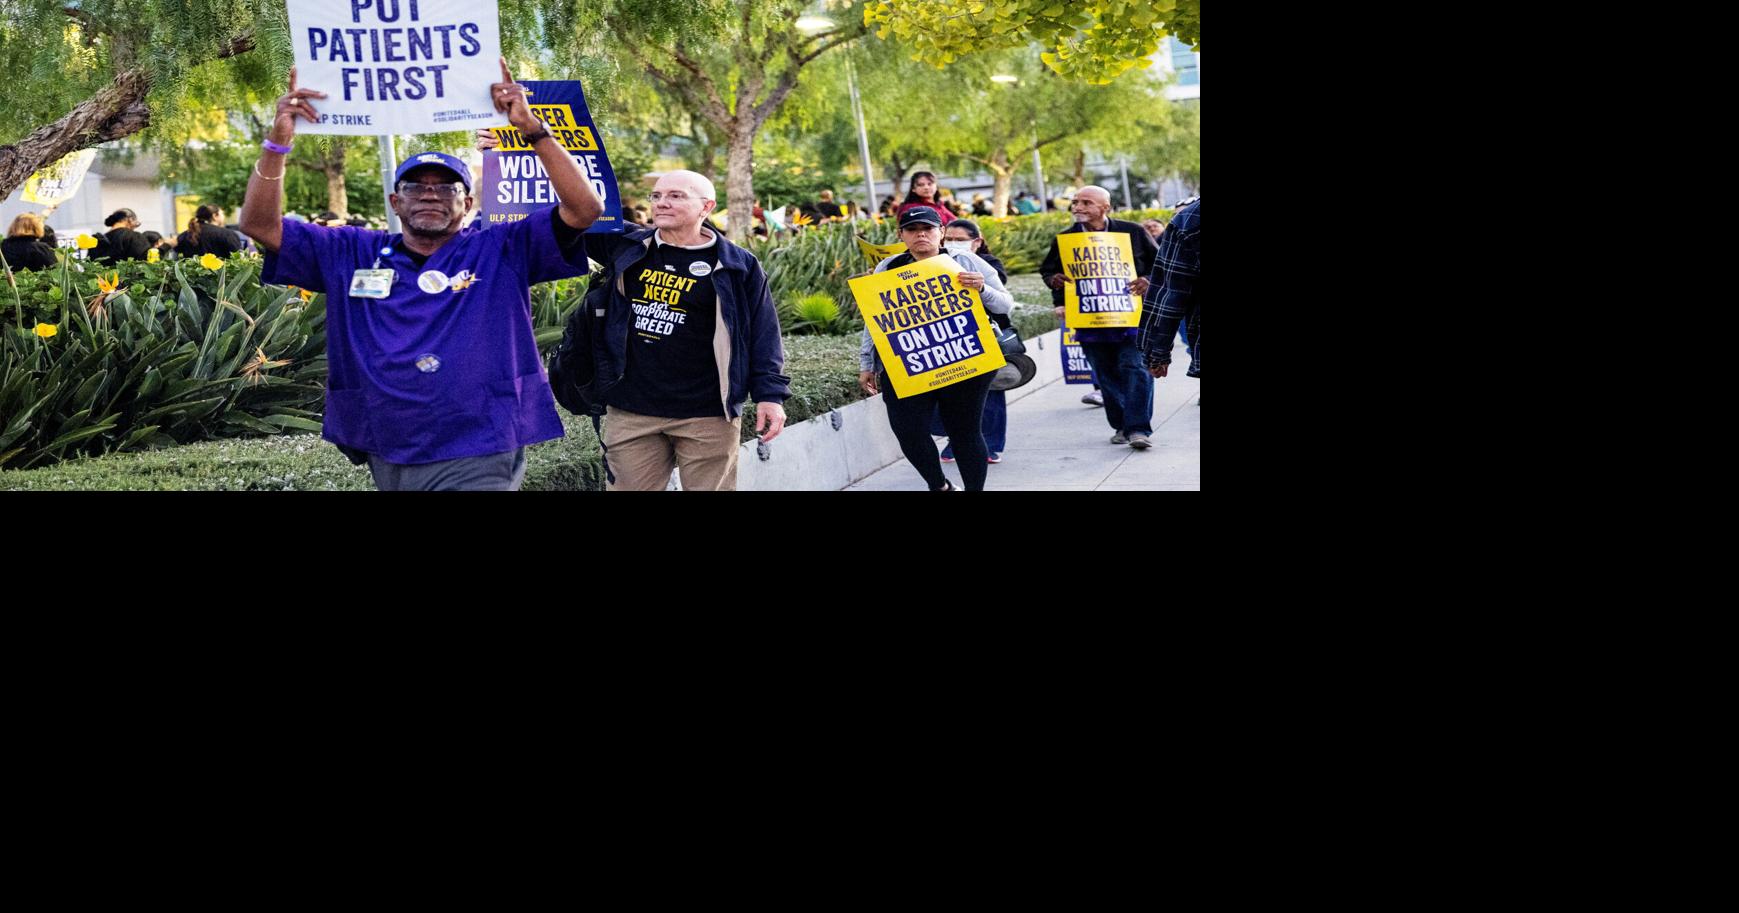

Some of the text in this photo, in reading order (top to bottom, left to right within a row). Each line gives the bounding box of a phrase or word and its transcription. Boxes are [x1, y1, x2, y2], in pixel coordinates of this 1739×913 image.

[308, 23, 481, 62] PATIENTS
[341, 65, 449, 101] FIRST
[315, 114, 373, 125] LP STRIKE
[531, 107, 569, 127] SER
[498, 154, 549, 179] WON
[497, 180, 607, 204] SILEND
[489, 213, 505, 222] ULP
[1072, 246, 1121, 262] KAISER
[639, 268, 697, 292] PATIENT
[1067, 262, 1131, 278] WORKERS
[643, 284, 681, 305] NEED
[879, 273, 955, 311] KAISER
[1079, 279, 1126, 295] ON ULP
[631, 303, 687, 324] CORPORATE
[872, 289, 974, 333] WORKERS
[1081, 295, 1132, 312] STRIKE
[634, 316, 674, 335] GREED
[897, 314, 968, 352] ON ULP
[906, 335, 980, 373] STRIKE
